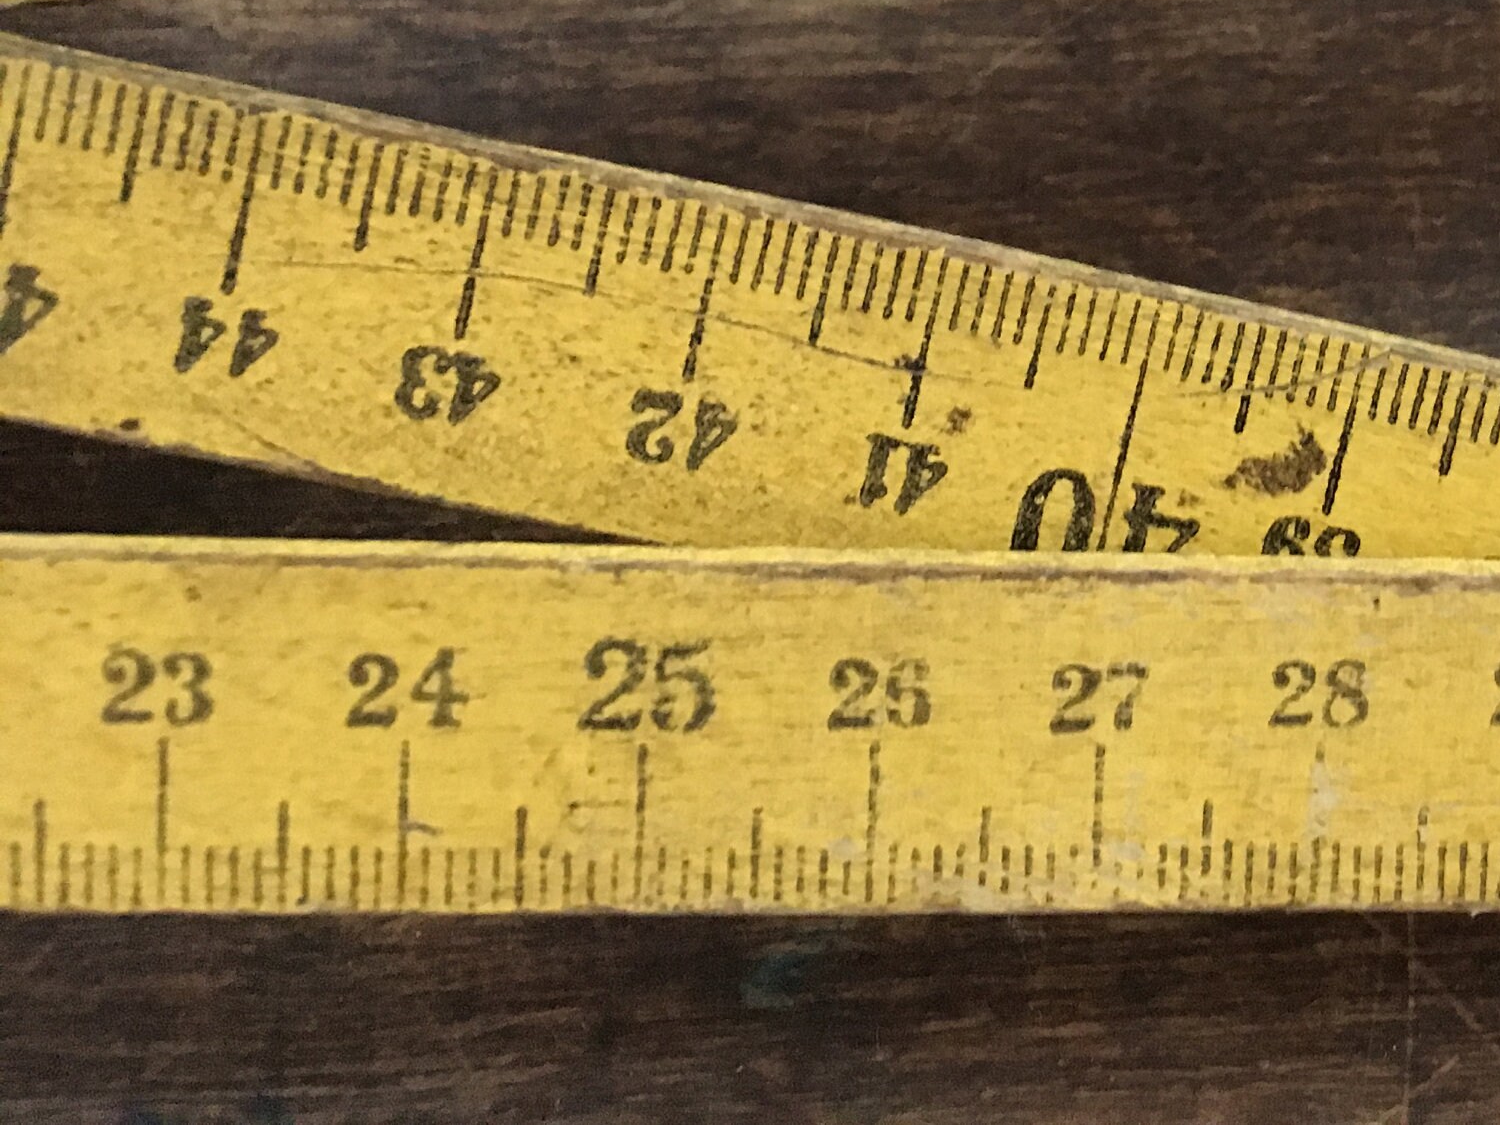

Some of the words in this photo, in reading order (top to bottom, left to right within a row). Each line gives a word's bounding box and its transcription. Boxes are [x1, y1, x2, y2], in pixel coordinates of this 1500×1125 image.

[173, 296, 279, 377] 44
[394, 345, 501, 426] 43
[625, 387, 740, 472] 42
[859, 431, 949, 517] 41
[100, 645, 214, 728] 23
[345, 646, 470, 728] 24
[577, 637, 717, 733] 25
[826, 658, 933, 732] 26
[1049, 662, 1150, 735] 27
[1268, 659, 1371, 729] 28
